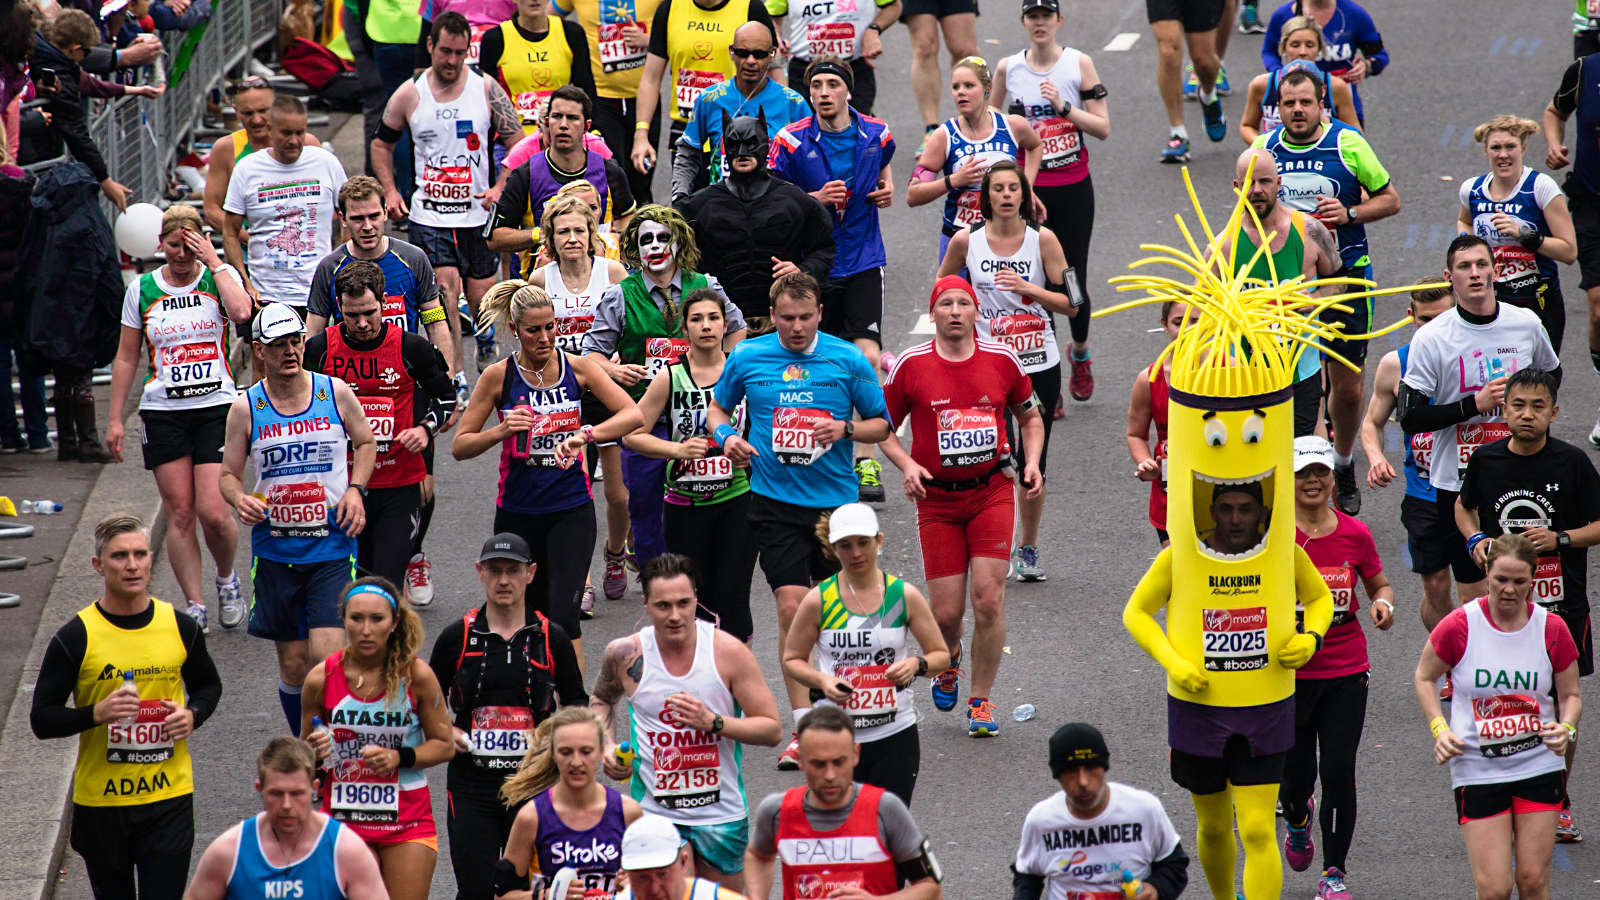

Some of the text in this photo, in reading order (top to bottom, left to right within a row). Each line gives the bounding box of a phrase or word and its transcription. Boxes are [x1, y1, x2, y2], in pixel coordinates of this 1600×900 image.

[802, 2, 834, 17] ACT
[687, 21, 724, 32] PAUL
[809, 41, 853, 54] 32415
[528, 52, 549, 62] LIZ
[436, 108, 459, 120] FOZ
[955, 143, 1010, 158] SOPHIE
[1045, 154, 1080, 169] #boost
[1276, 160, 1324, 172] CRAIG
[424, 183, 470, 200] 46063
[1289, 185, 1326, 197] mind
[1477, 202, 1523, 214] NICKY
[981, 260, 1032, 274] CHRISSY
[163, 294, 202, 312] PAULA
[565, 297, 592, 309] LIZ
[191, 319, 217, 331] Wish
[187, 347, 215, 356] money
[1497, 347, 1519, 355] DANIEL
[1021, 354, 1044, 366] oost
[171, 362, 213, 382] 8707
[333, 356, 388, 381] PAUL
[184, 383, 218, 396] #boost
[529, 386, 570, 407] KATE
[780, 392, 814, 403] MACS
[362, 402, 391, 412] money
[553, 417, 579, 427] money
[777, 408, 799, 428] Virgin
[940, 411, 993, 430] Virgin money
[258, 416, 331, 441] IAN JONES
[1461, 423, 1482, 443] Virgin
[940, 428, 996, 450] 56305
[261, 441, 319, 469] JDRF
[957, 452, 994, 465] #boost
[304, 465, 328, 473] DIABETES
[293, 486, 323, 498] money
[692, 481, 730, 493] #boost
[1498, 489, 1535, 504] RUNNING
[1536, 494, 1556, 513] CREW
[270, 503, 327, 523] 40569
[1536, 562, 1559, 573] oney
[1209, 574, 1262, 588] BLACKBURN
[1206, 609, 1265, 631] Virgin money
[829, 631, 873, 649] JULIE
[1205, 630, 1266, 652] 22025
[842, 650, 873, 662] John
[1223, 658, 1265, 671] #boost
[1474, 668, 1539, 692] DANI
[1503, 700, 1537, 711] money
[110, 724, 170, 745] 51605
[1480, 715, 1542, 740] 48946
[336, 731, 404, 744] The BRAIN
[1501, 736, 1541, 755] #boost
[127, 749, 169, 763] #boost
[683, 751, 716, 763] money
[103, 771, 171, 796] ADAM
[655, 768, 719, 790] 32158
[333, 783, 396, 804] 19608
[674, 794, 717, 808] #boost
[1042, 822, 1143, 852] HARMANDER
[550, 838, 619, 864] Stroke
[795, 840, 865, 863] PAUL
[1072, 861, 1122, 880] age UK
[265, 879, 304, 899] KIPS
